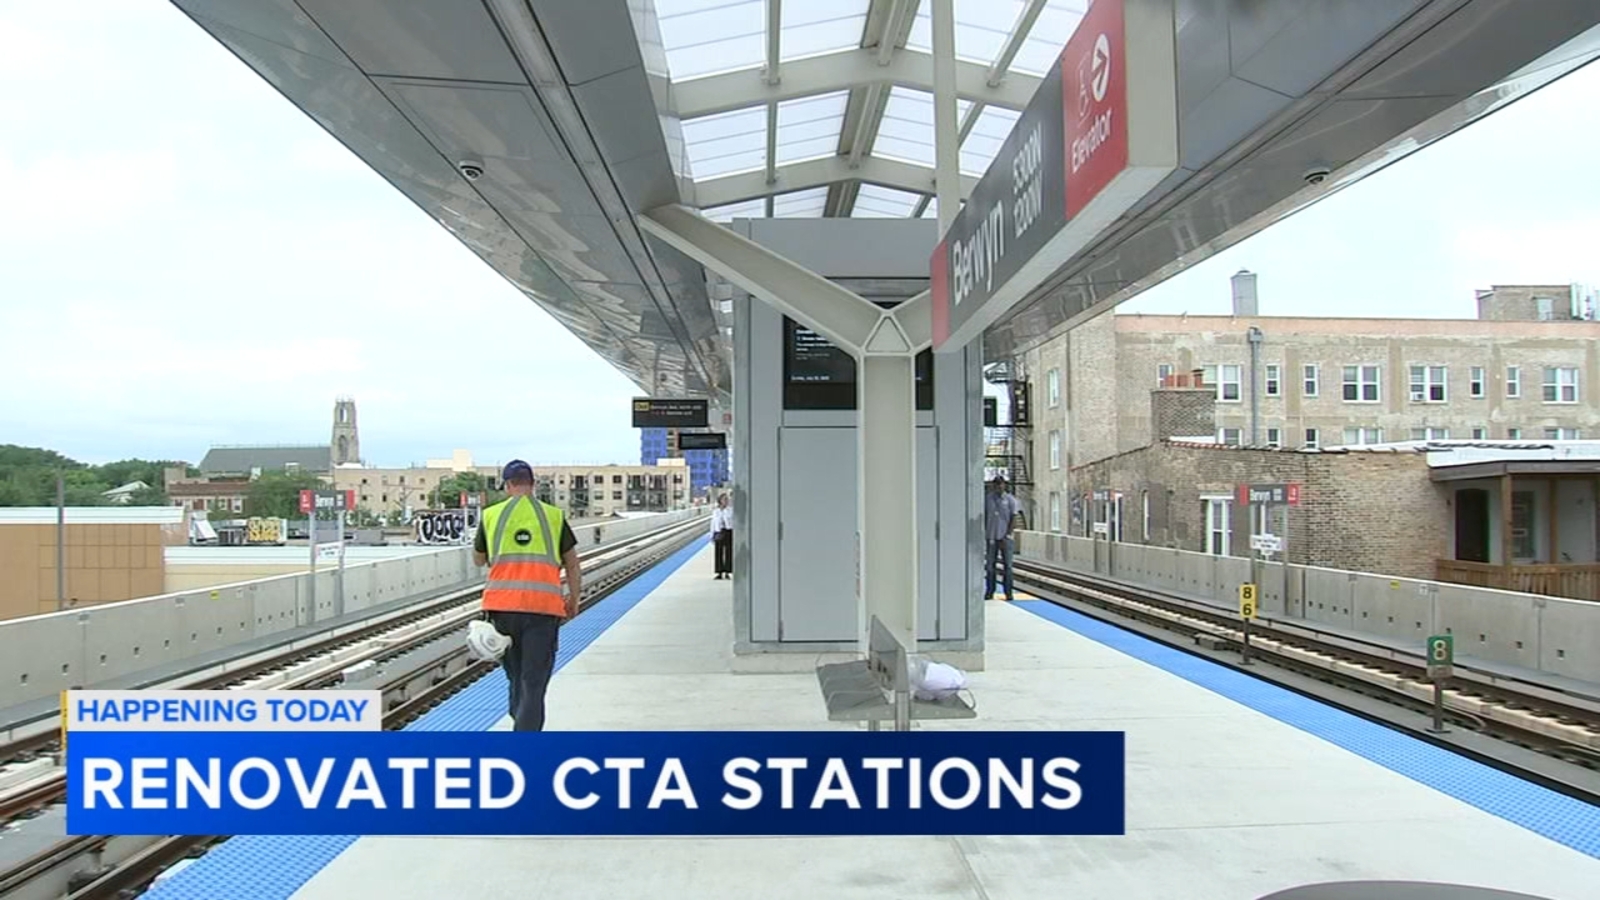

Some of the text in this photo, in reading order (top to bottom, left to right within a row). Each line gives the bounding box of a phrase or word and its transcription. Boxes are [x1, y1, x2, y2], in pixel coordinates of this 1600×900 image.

[1012, 121, 1042, 195] 5300N
[1070, 108, 1111, 174] Elevator
[1013, 169, 1043, 239] 1200W
[952, 199, 1005, 305] Berwyn
[1242, 586, 1253, 600] 8
[1242, 603, 1253, 617] 6
[1433, 639, 1447, 661] 8
